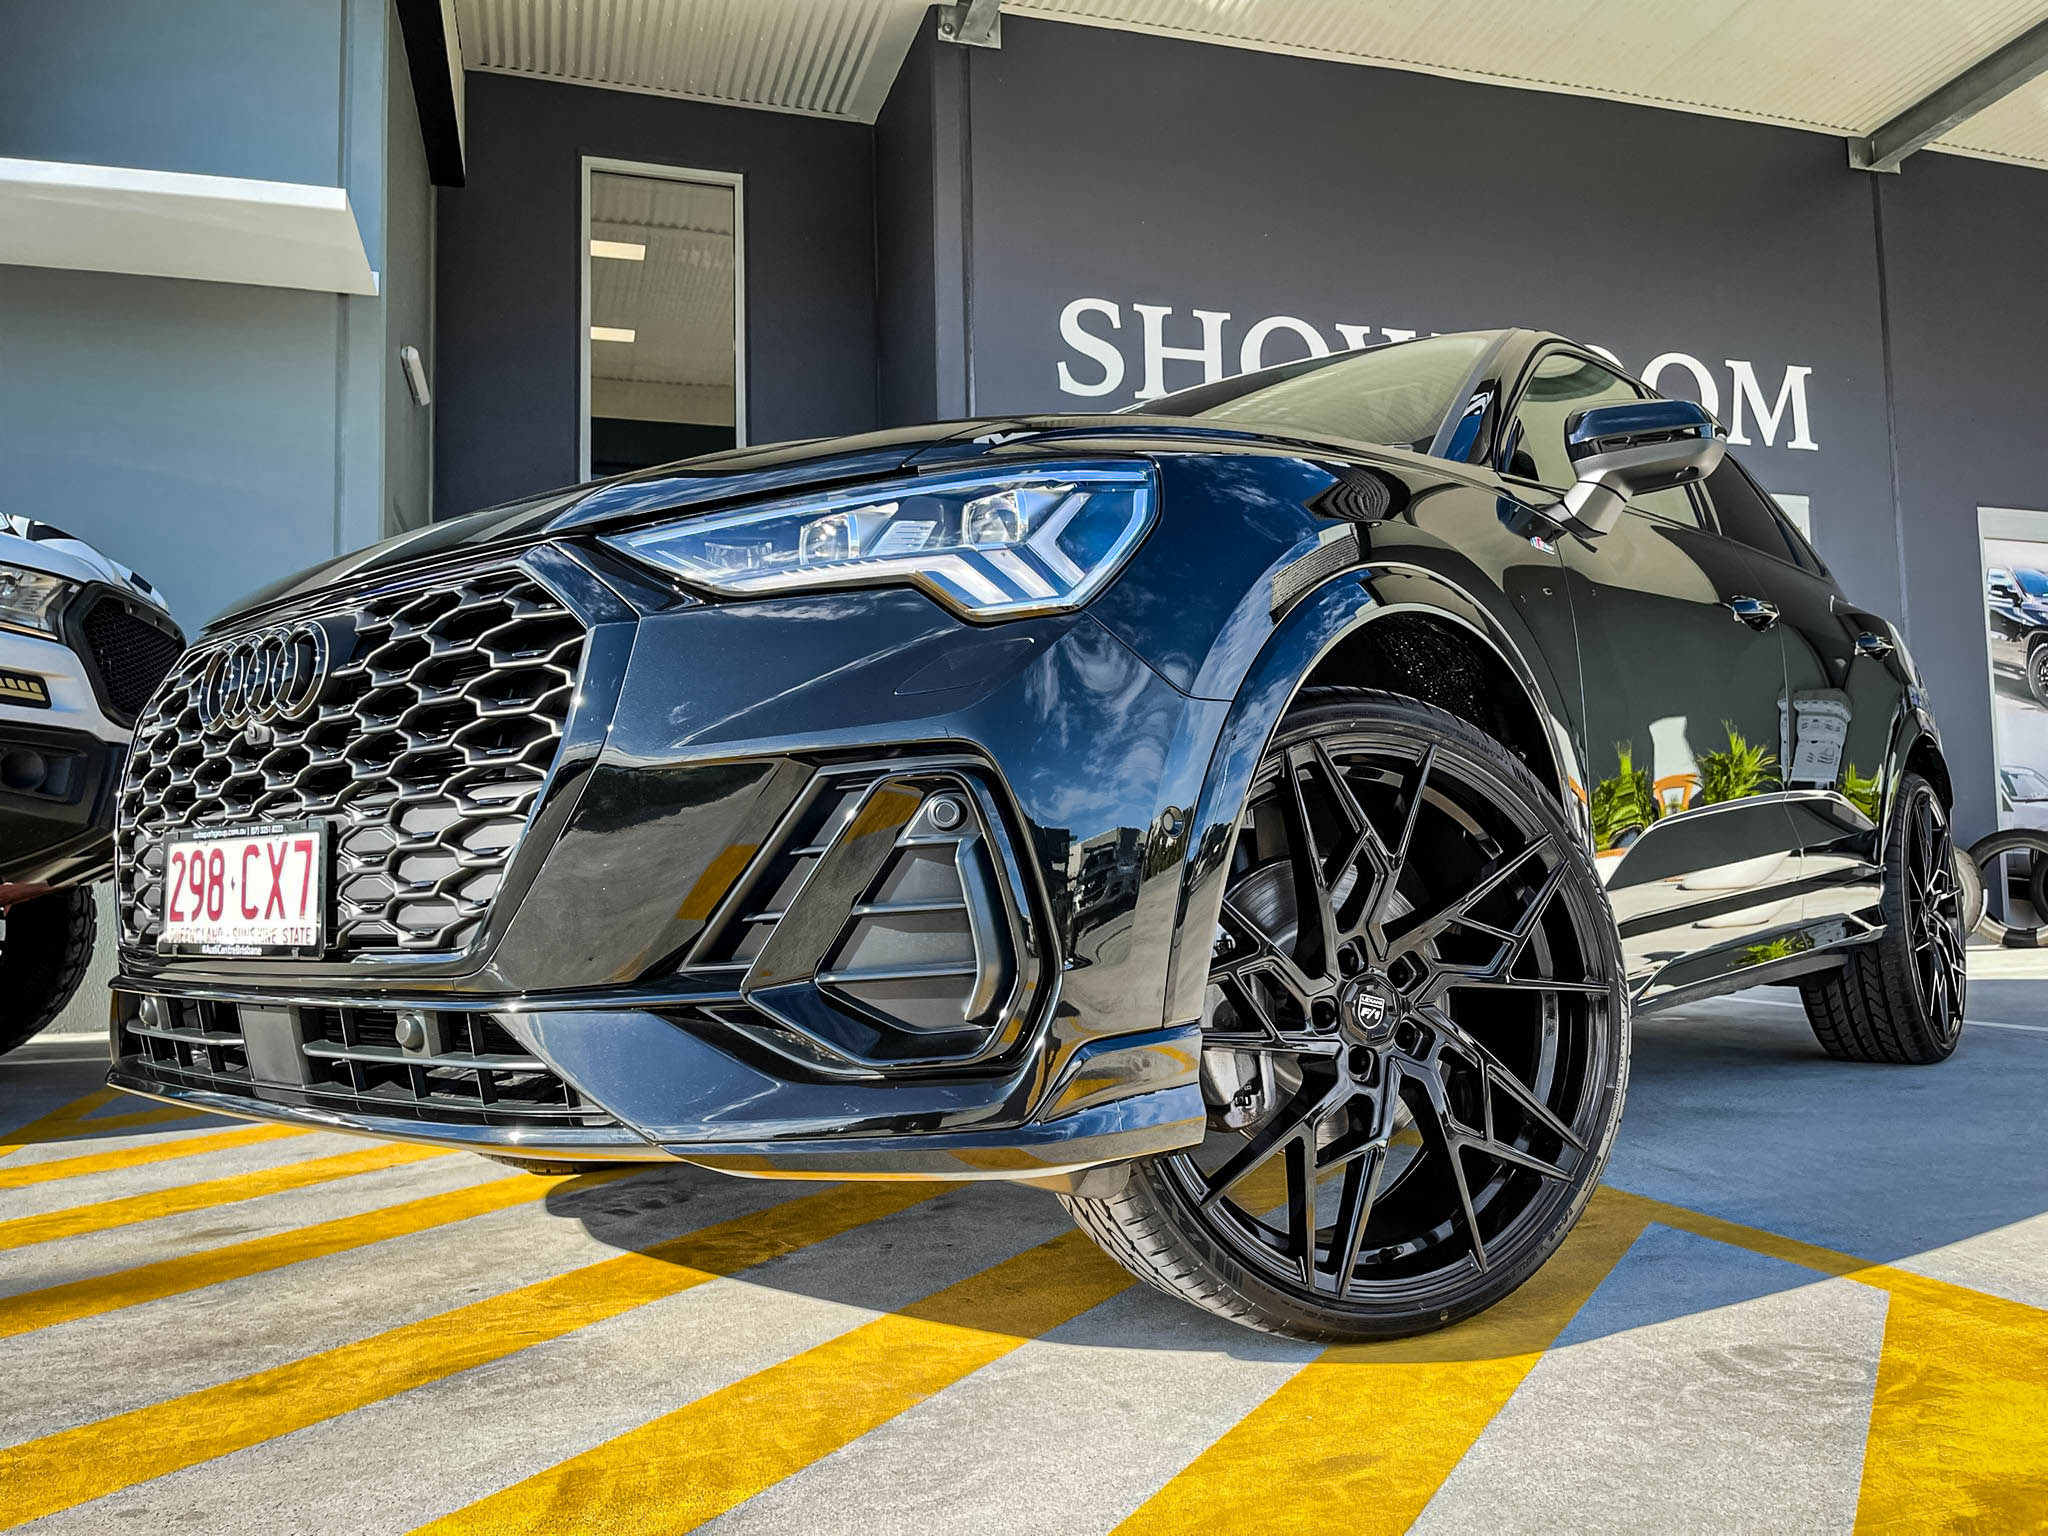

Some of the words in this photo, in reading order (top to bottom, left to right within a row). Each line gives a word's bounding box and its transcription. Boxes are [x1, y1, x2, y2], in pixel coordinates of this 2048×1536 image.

[1057, 297, 1819, 451] SHOOM
[169, 848, 225, 923] 298
[240, 839, 314, 921] CX7
[282, 927, 312, 945] STATE
